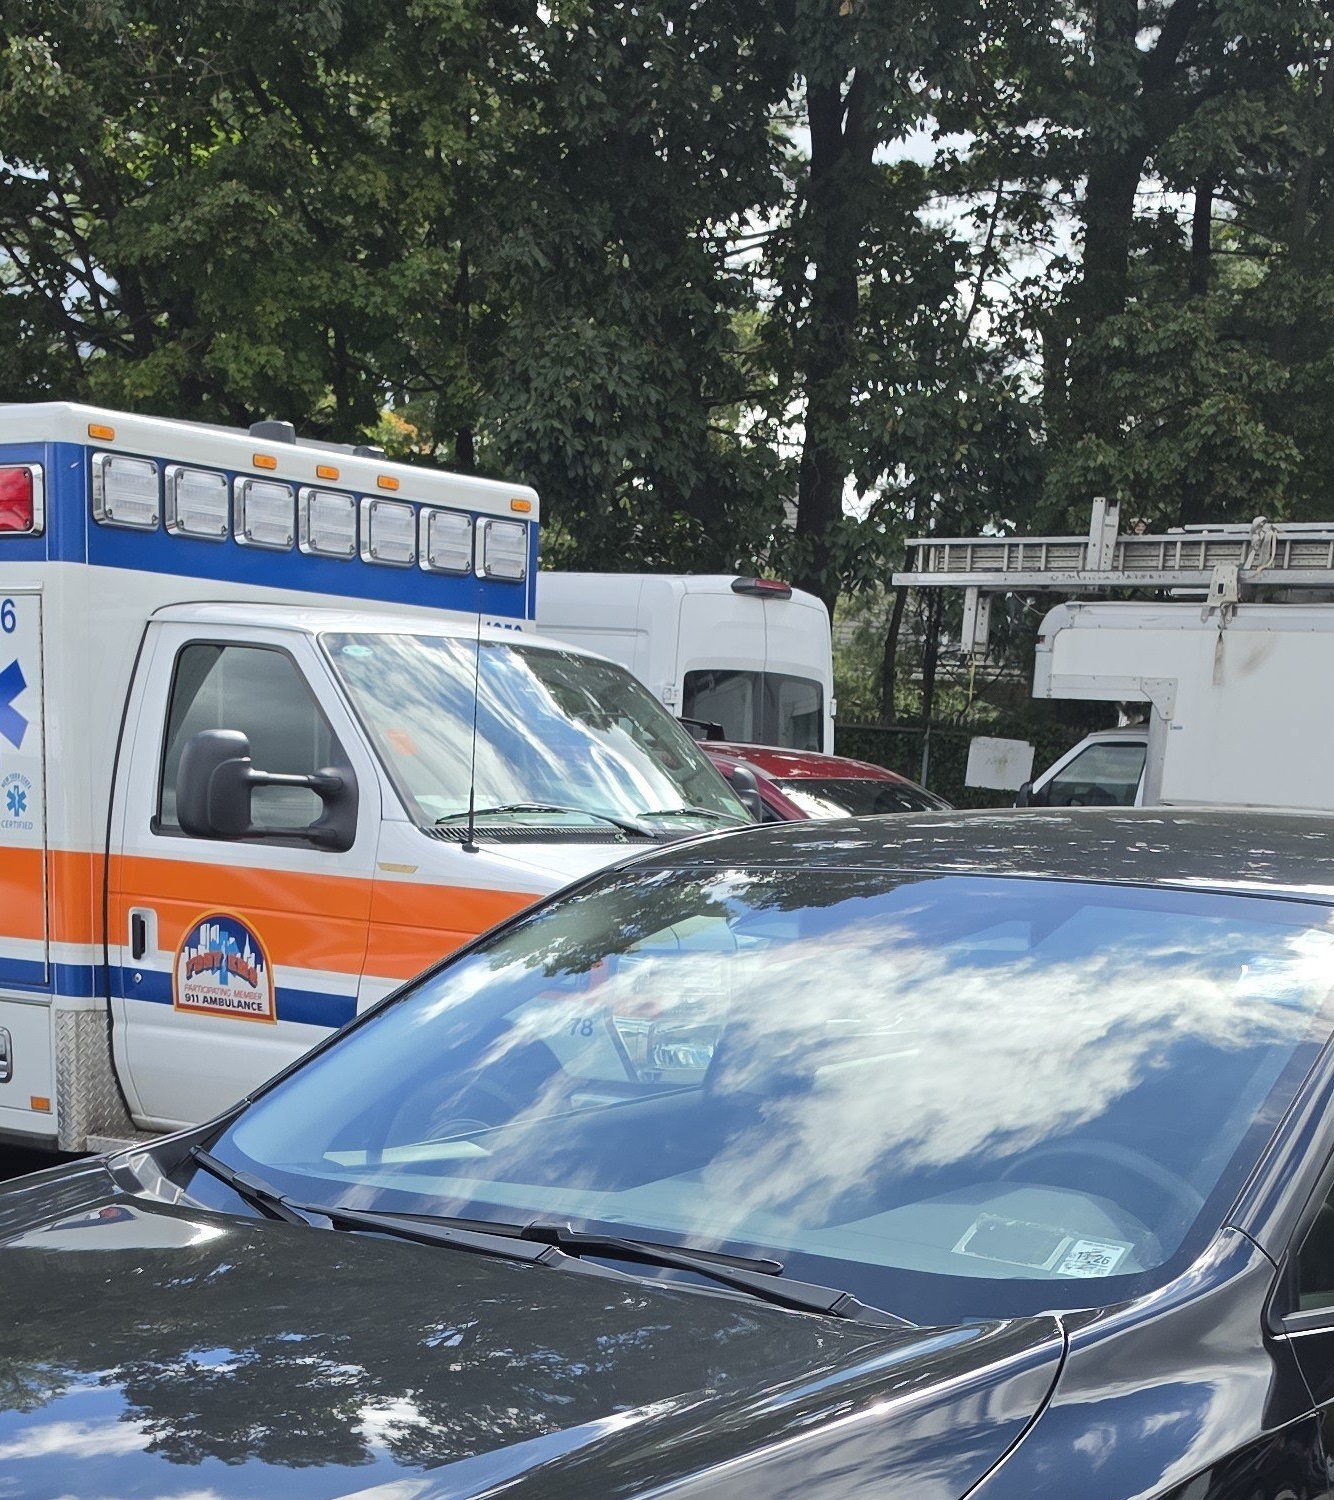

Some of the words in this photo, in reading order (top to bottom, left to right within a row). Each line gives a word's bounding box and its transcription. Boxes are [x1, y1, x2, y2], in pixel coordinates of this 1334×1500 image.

[0, 820, 34, 830] CERTIFIED
[184, 983, 231, 998] PARTICIPATING
[233, 989, 263, 1001] MEMBER
[185, 993, 200, 1004] 911
[202, 995, 264, 1012] AMBULANCE
